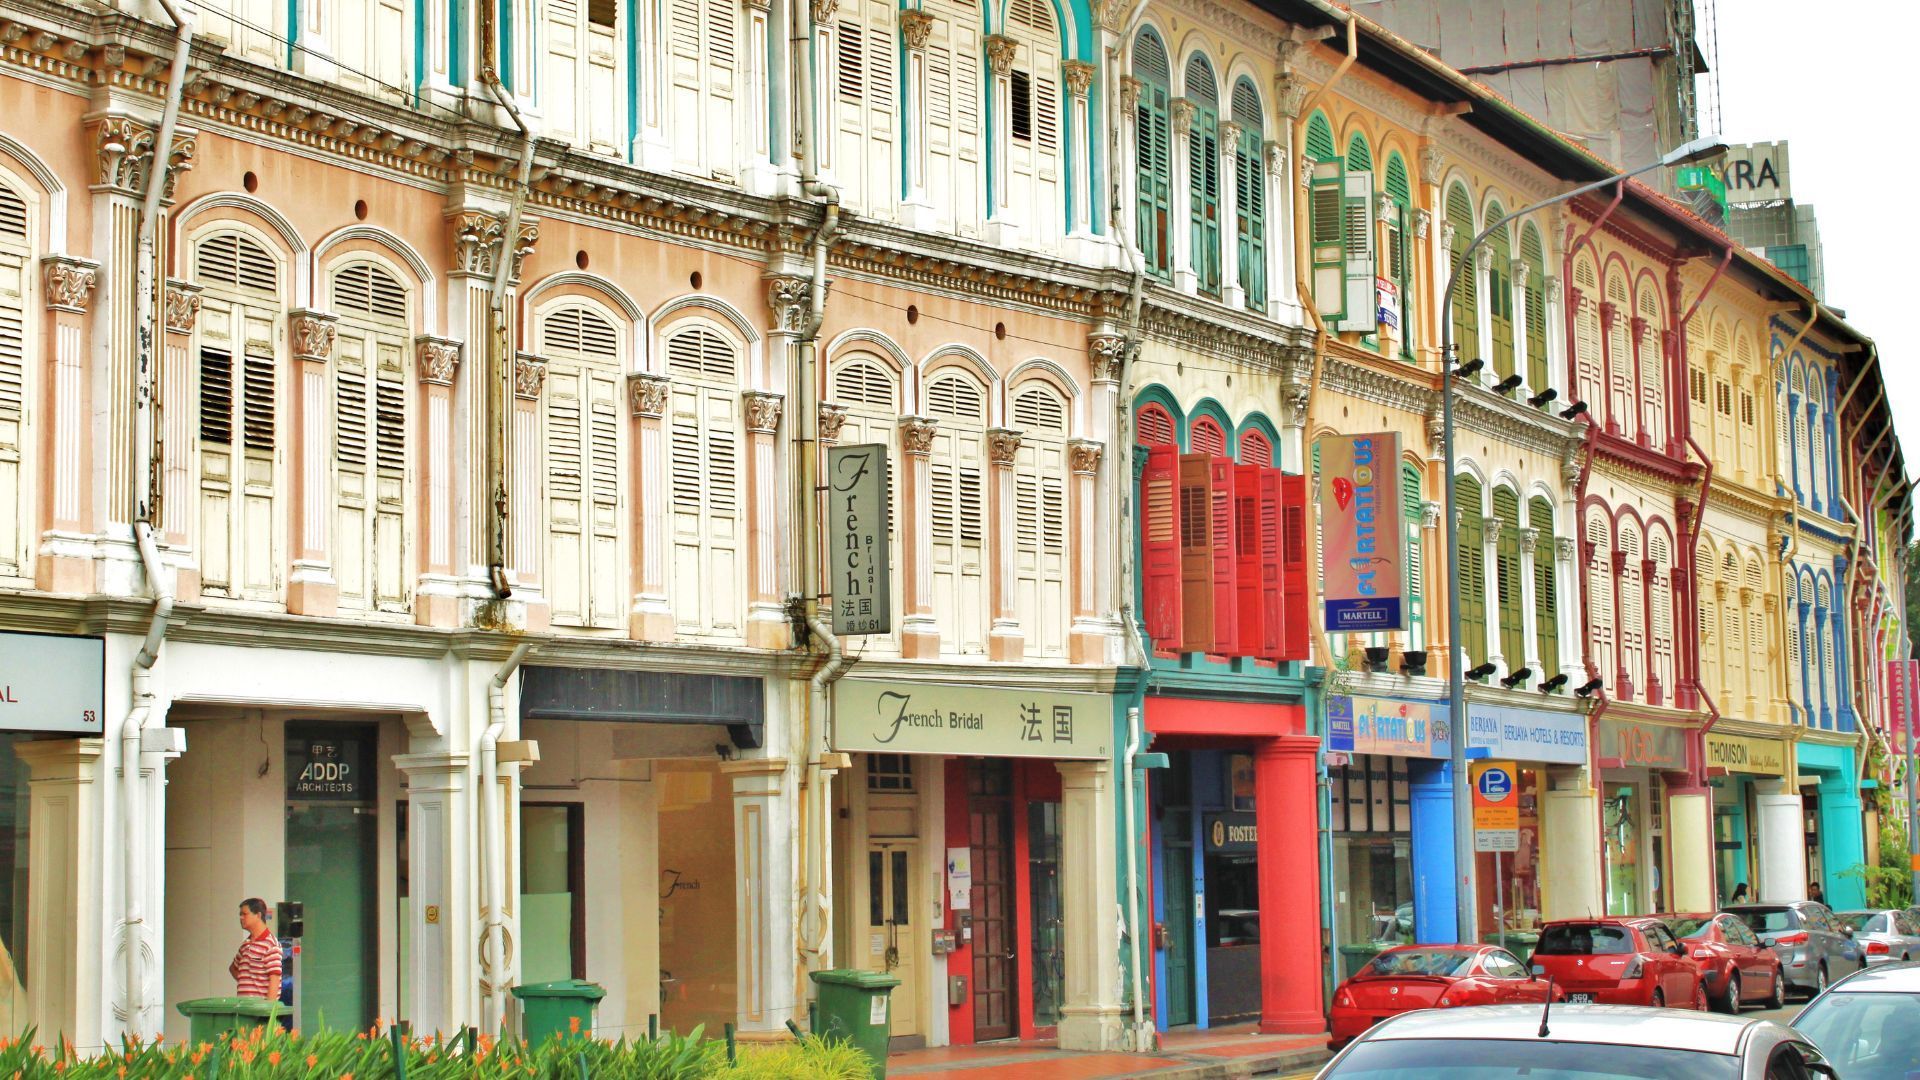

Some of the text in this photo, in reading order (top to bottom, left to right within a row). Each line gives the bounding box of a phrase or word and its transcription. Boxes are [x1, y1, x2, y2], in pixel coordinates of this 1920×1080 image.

[833, 453, 870, 596] French
[866, 535, 874, 594] Bridal
[841, 598, 872, 617] 法国
[1343, 611, 1382, 621] MARTELL
[869, 618, 879, 630] 61
[83, 710, 96, 722] 53
[873, 690, 984, 744] French Bridal
[1020, 702, 1073, 744] 法国
[1470, 716, 1498, 735] BERJAYA
[1504, 725, 1584, 747] BERJAYA HOTELS & RESORTS
[1709, 741, 1747, 765] THOMSON
[300, 763, 350, 780] ADDP
[1485, 770, 1505, 793] P
[296, 783, 353, 792] ARCHITECTS
